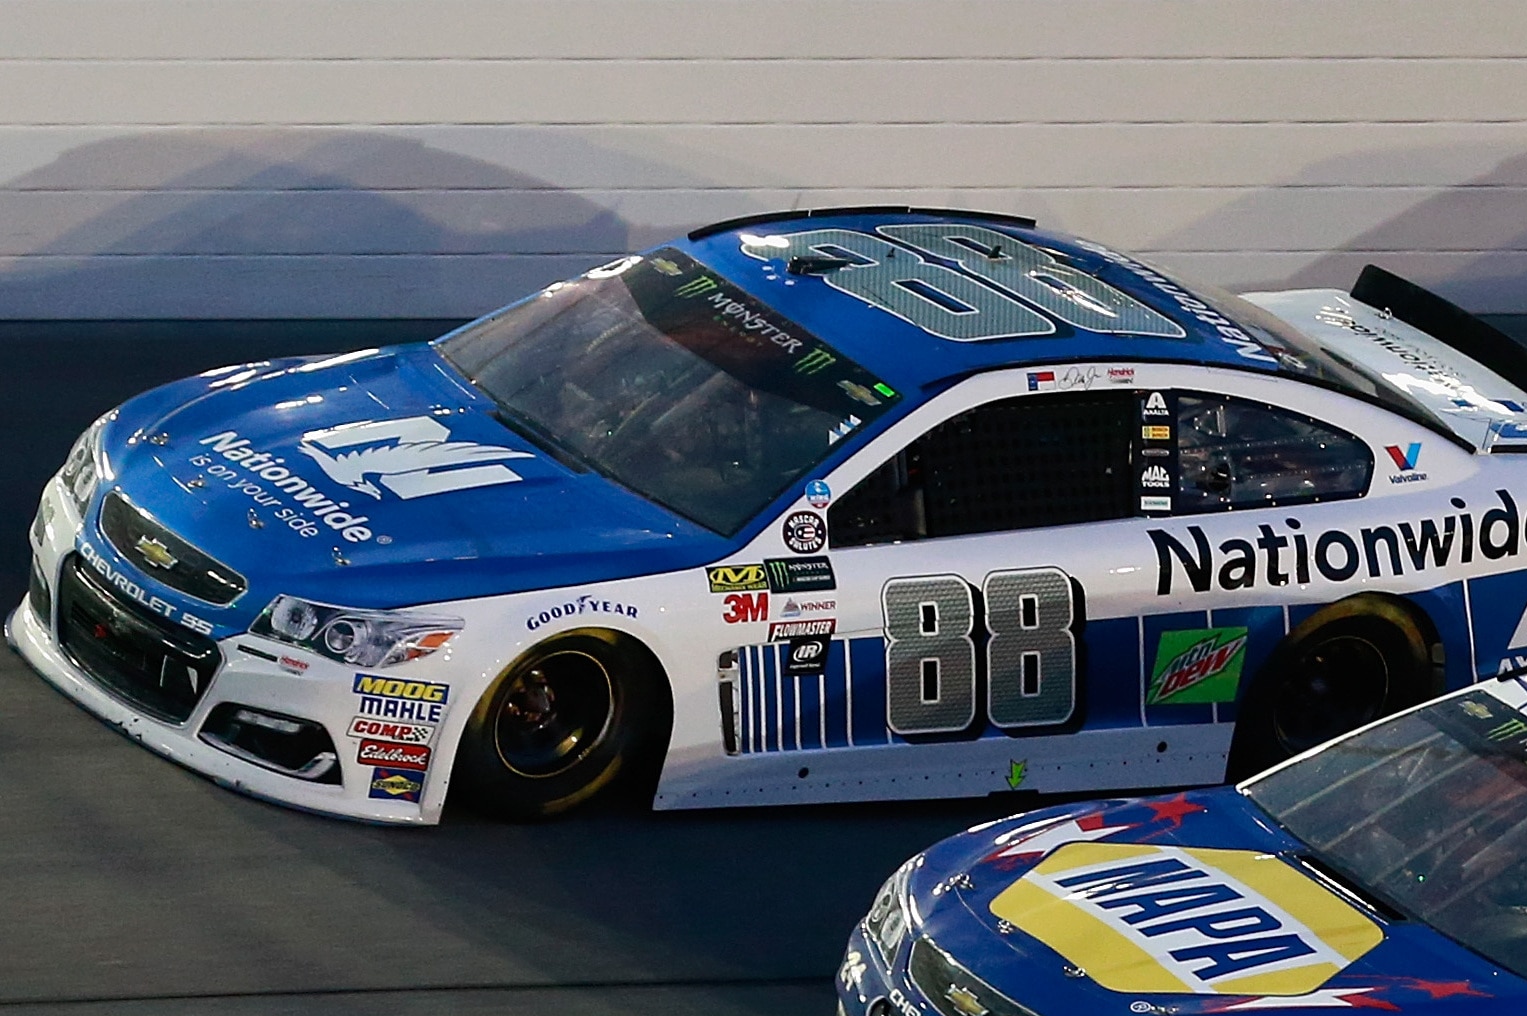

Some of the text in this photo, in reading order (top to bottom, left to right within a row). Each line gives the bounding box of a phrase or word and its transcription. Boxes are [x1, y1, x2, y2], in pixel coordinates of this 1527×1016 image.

[740, 224, 1187, 342] 88
[708, 292, 803, 354] MONSTER
[1142, 465, 1169, 481] MAC
[1389, 472, 1427, 484] Valvoline
[188, 453, 318, 538] is on your side
[200, 429, 372, 543] Nationwide
[788, 515, 819, 528] NASCAR
[788, 537, 822, 551] SALUTES
[79, 541, 214, 635] CHEVROLET SS
[527, 595, 638, 631] GOODYEAR
[723, 592, 769, 623] 3M
[801, 601, 836, 611] WINNER
[771, 620, 833, 642] FLOWMASTER
[881, 566, 1077, 736] 88
[357, 677, 446, 700] MOOG
[359, 697, 442, 722] MAHLE
[353, 721, 413, 740] COMP
[360, 745, 427, 765] Edelbrock
[1053, 855, 1319, 982] NAPA
